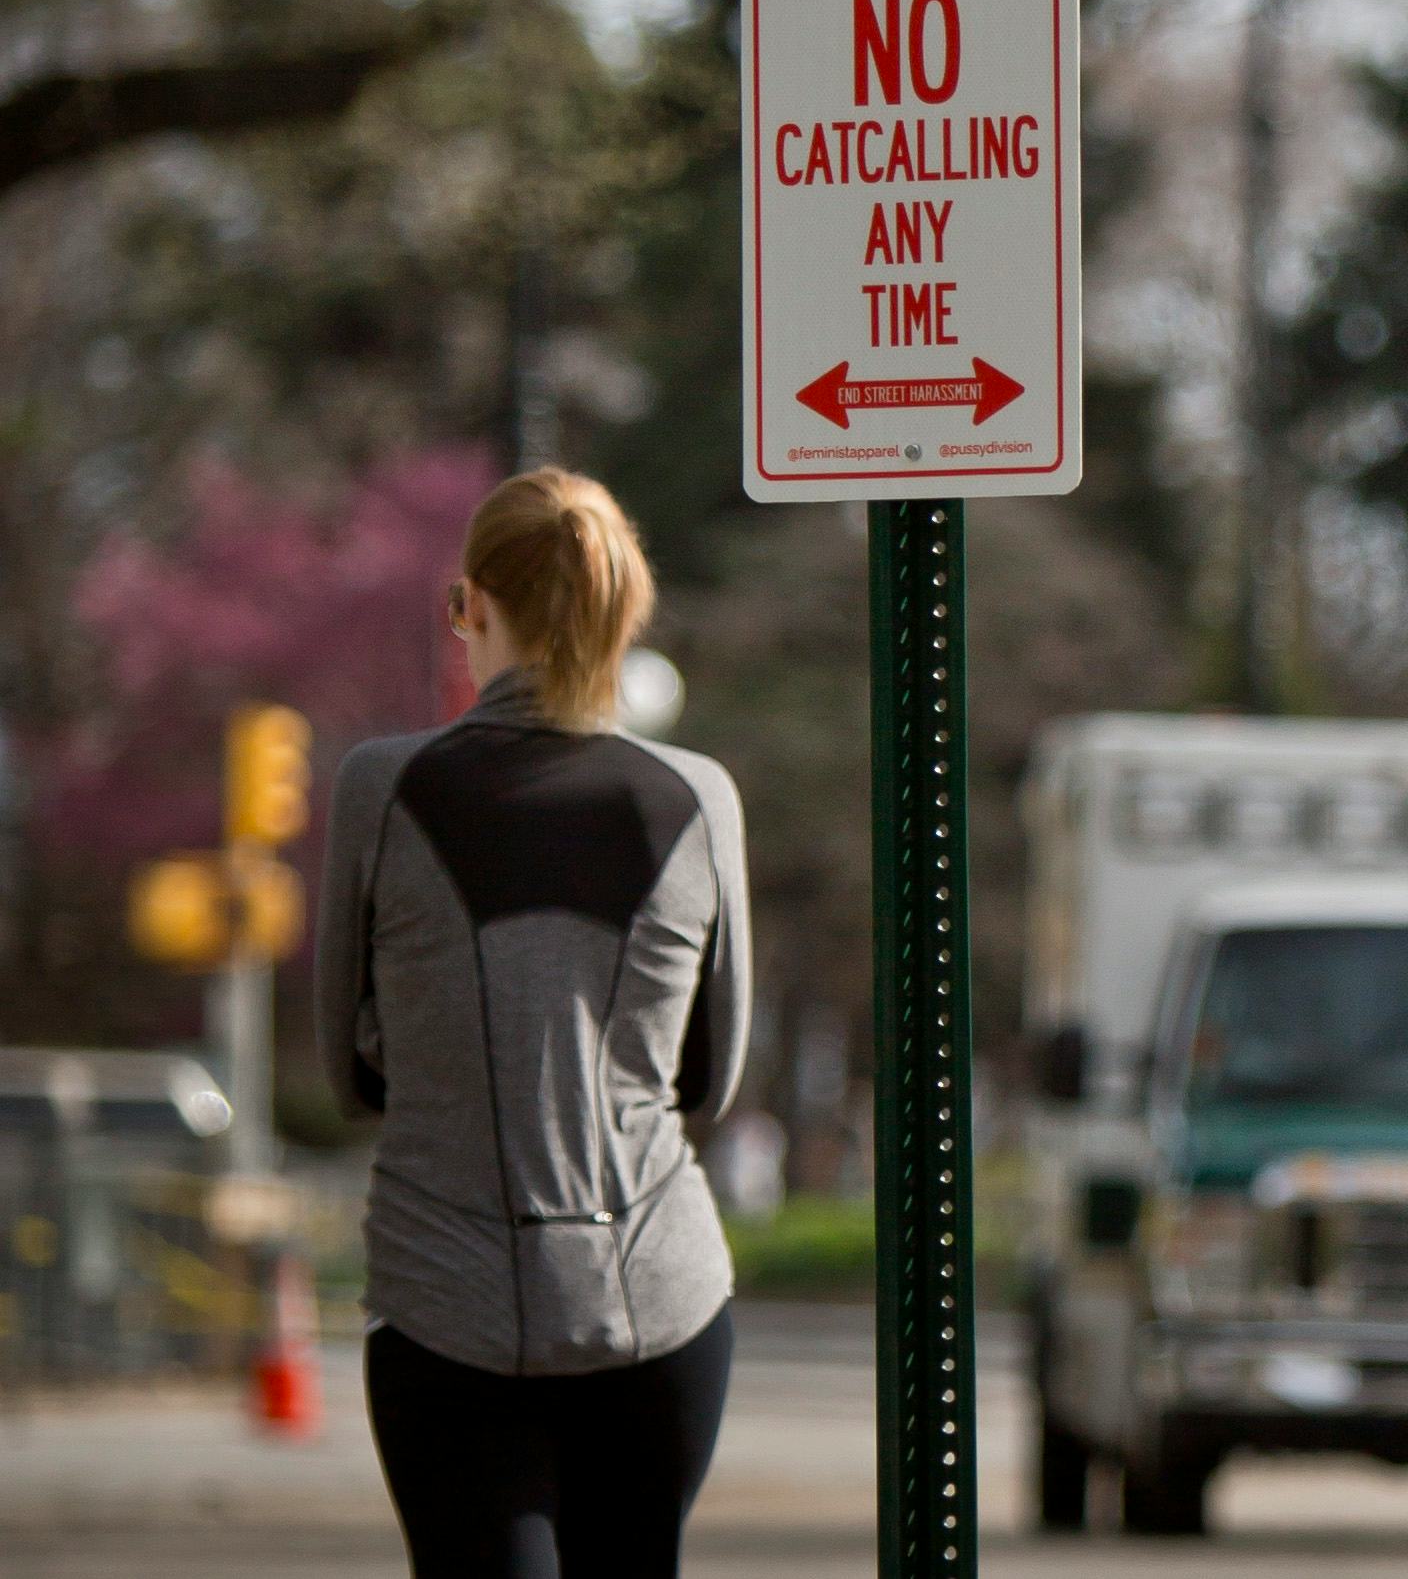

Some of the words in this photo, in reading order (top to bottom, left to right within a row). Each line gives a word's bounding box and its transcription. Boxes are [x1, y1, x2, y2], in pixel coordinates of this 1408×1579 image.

[776, 114, 1040, 186] CATCALLING
[864, 200, 954, 265] ANY
[862, 282, 959, 347] TIME
[837, 387, 860, 405] END
[864, 386, 906, 404] STREET
[909, 382, 984, 402] HARASSMENT
[787, 445, 901, 462] @feministapparel
[939, 440, 1034, 458] @pussydivision
